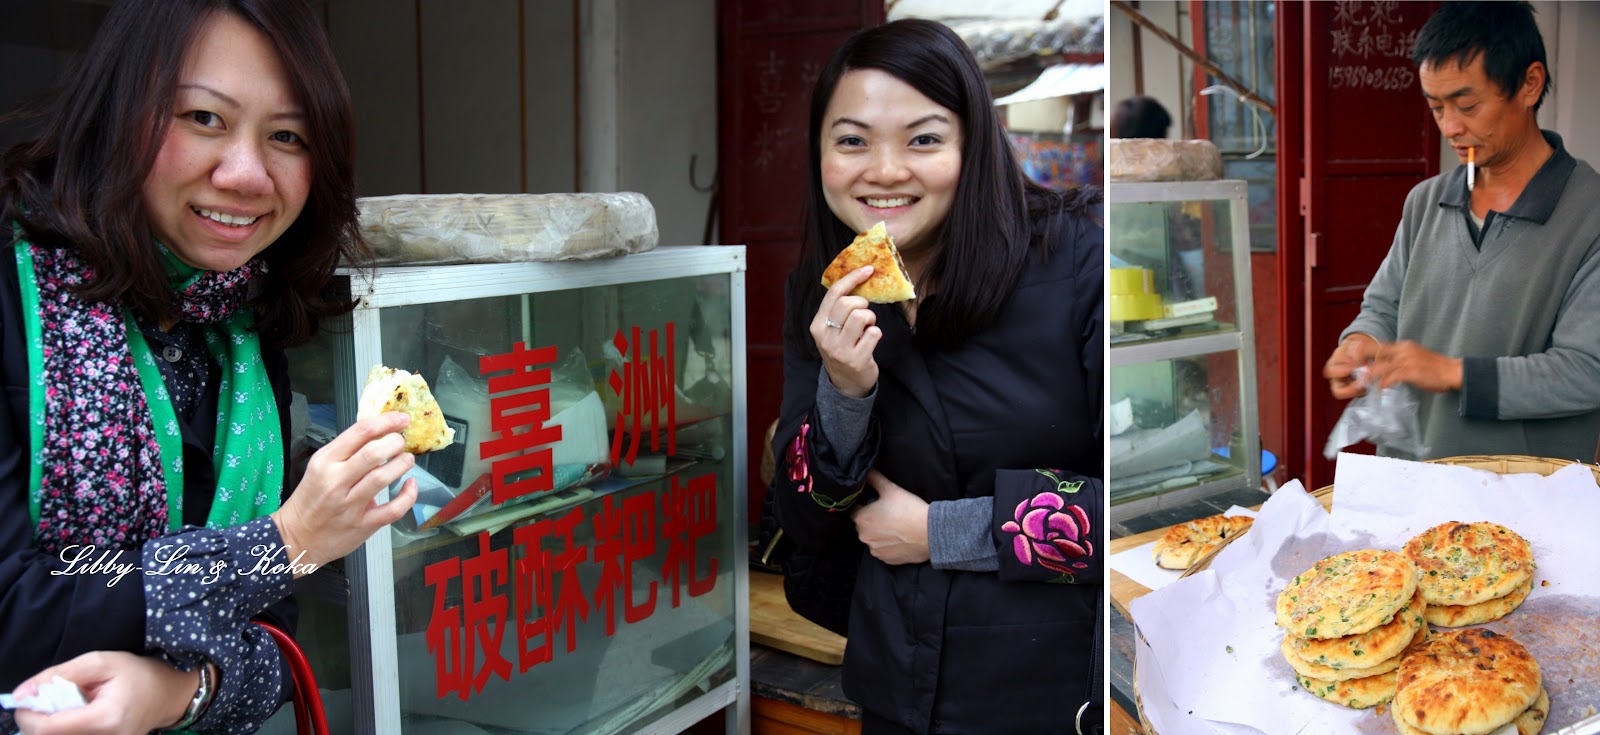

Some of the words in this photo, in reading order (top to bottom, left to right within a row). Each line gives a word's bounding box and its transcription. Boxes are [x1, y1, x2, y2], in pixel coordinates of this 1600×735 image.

[480, 322, 676, 505] 喜洲
[424, 472, 719, 702] 破酥粑粑
